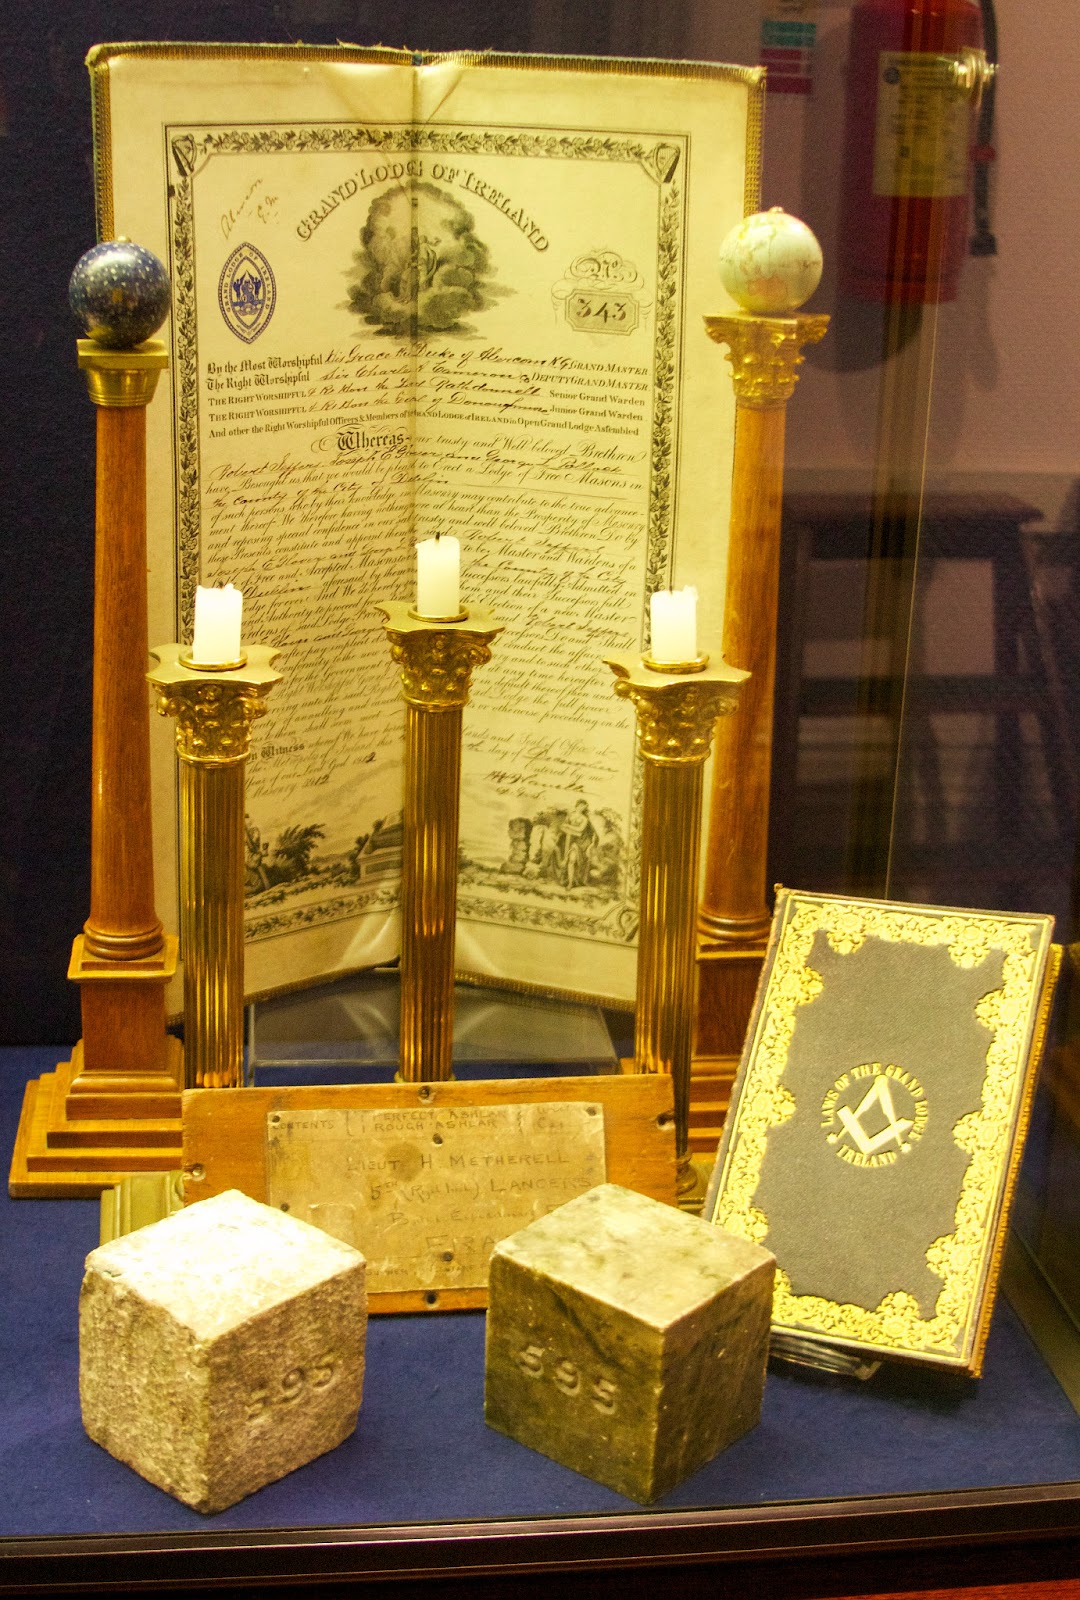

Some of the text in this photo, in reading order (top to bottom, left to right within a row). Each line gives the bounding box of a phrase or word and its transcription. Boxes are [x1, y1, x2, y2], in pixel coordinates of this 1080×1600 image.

[296, 178, 357, 242] GRAND
[430, 162, 459, 183] OF
[459, 170, 549, 253] IRELAND
[227, 253, 243, 279] LODGE
[249, 251, 258, 261] OF
[261, 266, 271, 310] IRELAND
[576, 299, 626, 323] 343
[207, 362, 223, 375] By
[224, 359, 238, 372] the
[240, 359, 266, 371] Most
[268, 354, 323, 369] Worshipful
[348, 345, 390, 364] Grace
[569, 360, 604, 372] GRAND
[605, 364, 649, 376] MASTER
[206, 378, 225, 393] The
[226, 375, 252, 390] Right
[254, 371, 310, 387] Worshipful
[531, 373, 570, 385] DEPUTY
[570, 376, 606, 388] GRAND
[607, 379, 648, 392] MASTER
[208, 397, 227, 407] THE
[228, 396, 254, 405] RIGHT
[257, 390, 307, 403] WORSHIPFUL
[549, 389, 577, 400] Senior
[579, 392, 607, 403] Grand
[609, 395, 646, 406] Warden
[209, 413, 227, 422] THE
[228, 411, 254, 421] RIGHT
[257, 407, 307, 417] WORSHIPFUL
[549, 405, 577, 416] Junior
[579, 408, 606, 418] Grand
[608, 410, 643, 421] Warden
[209, 429, 226, 438] And
[228, 427, 250, 437] other
[252, 426, 263, 434] the
[265, 423, 286, 435] Right
[286, 418, 329, 430] Worshipful
[330, 417, 359, 426] Officers
[359, 415, 365, 423] &
[365, 413, 399, 422] Members
[400, 410, 408, 418] of
[439, 411, 464, 419] LODGE
[471, 414, 509, 424] IRELAND
[518, 418, 540, 428] Open
[540, 419, 568, 429] Grand
[568, 421, 594, 433] Lodge
[436, 435, 469, 449] trusty
[473, 438, 496, 448] and
[302, 471, 324, 485] that
[342, 464, 373, 478] would
[375, 466, 385, 477] be
[477, 463, 514, 484] Lodge
[517, 469, 533, 484] of
[530, 469, 562, 482] Free
[564, 473, 628, 489] Masons
[631, 482, 643, 490] in
[223, 510, 245, 521] such
[249, 505, 285, 528] persons
[460, 492, 483, 504] may
[483, 493, 537, 506] contribute
[551, 497, 567, 510] the
[569, 502, 590, 513] true
[341, 507, 375, 521] having
[447, 501, 474, 516] heart
[476, 504, 501, 516] than
[505, 505, 521, 517] the
[276, 525, 309, 542] special
[312, 522, 361, 541] confidence
[499, 520, 537, 533] beloved
[322, 535, 341, 547] and
[566, 552, 615, 569] Wardens
[503, 668, 525, 678] any
[528, 670, 555, 679] time
[821, 1062, 928, 1141] LAWS OF THE GRAND LODGE
[374, 1118, 498, 1132] ROUGH ASHLAR
[420, 1153, 433, 1169] H
[449, 1153, 570, 1167] METHERELL
[836, 1144, 897, 1168] IRELAND
[489, 1177, 592, 1194] LANCERS
[242, 1350, 334, 1424] 595
